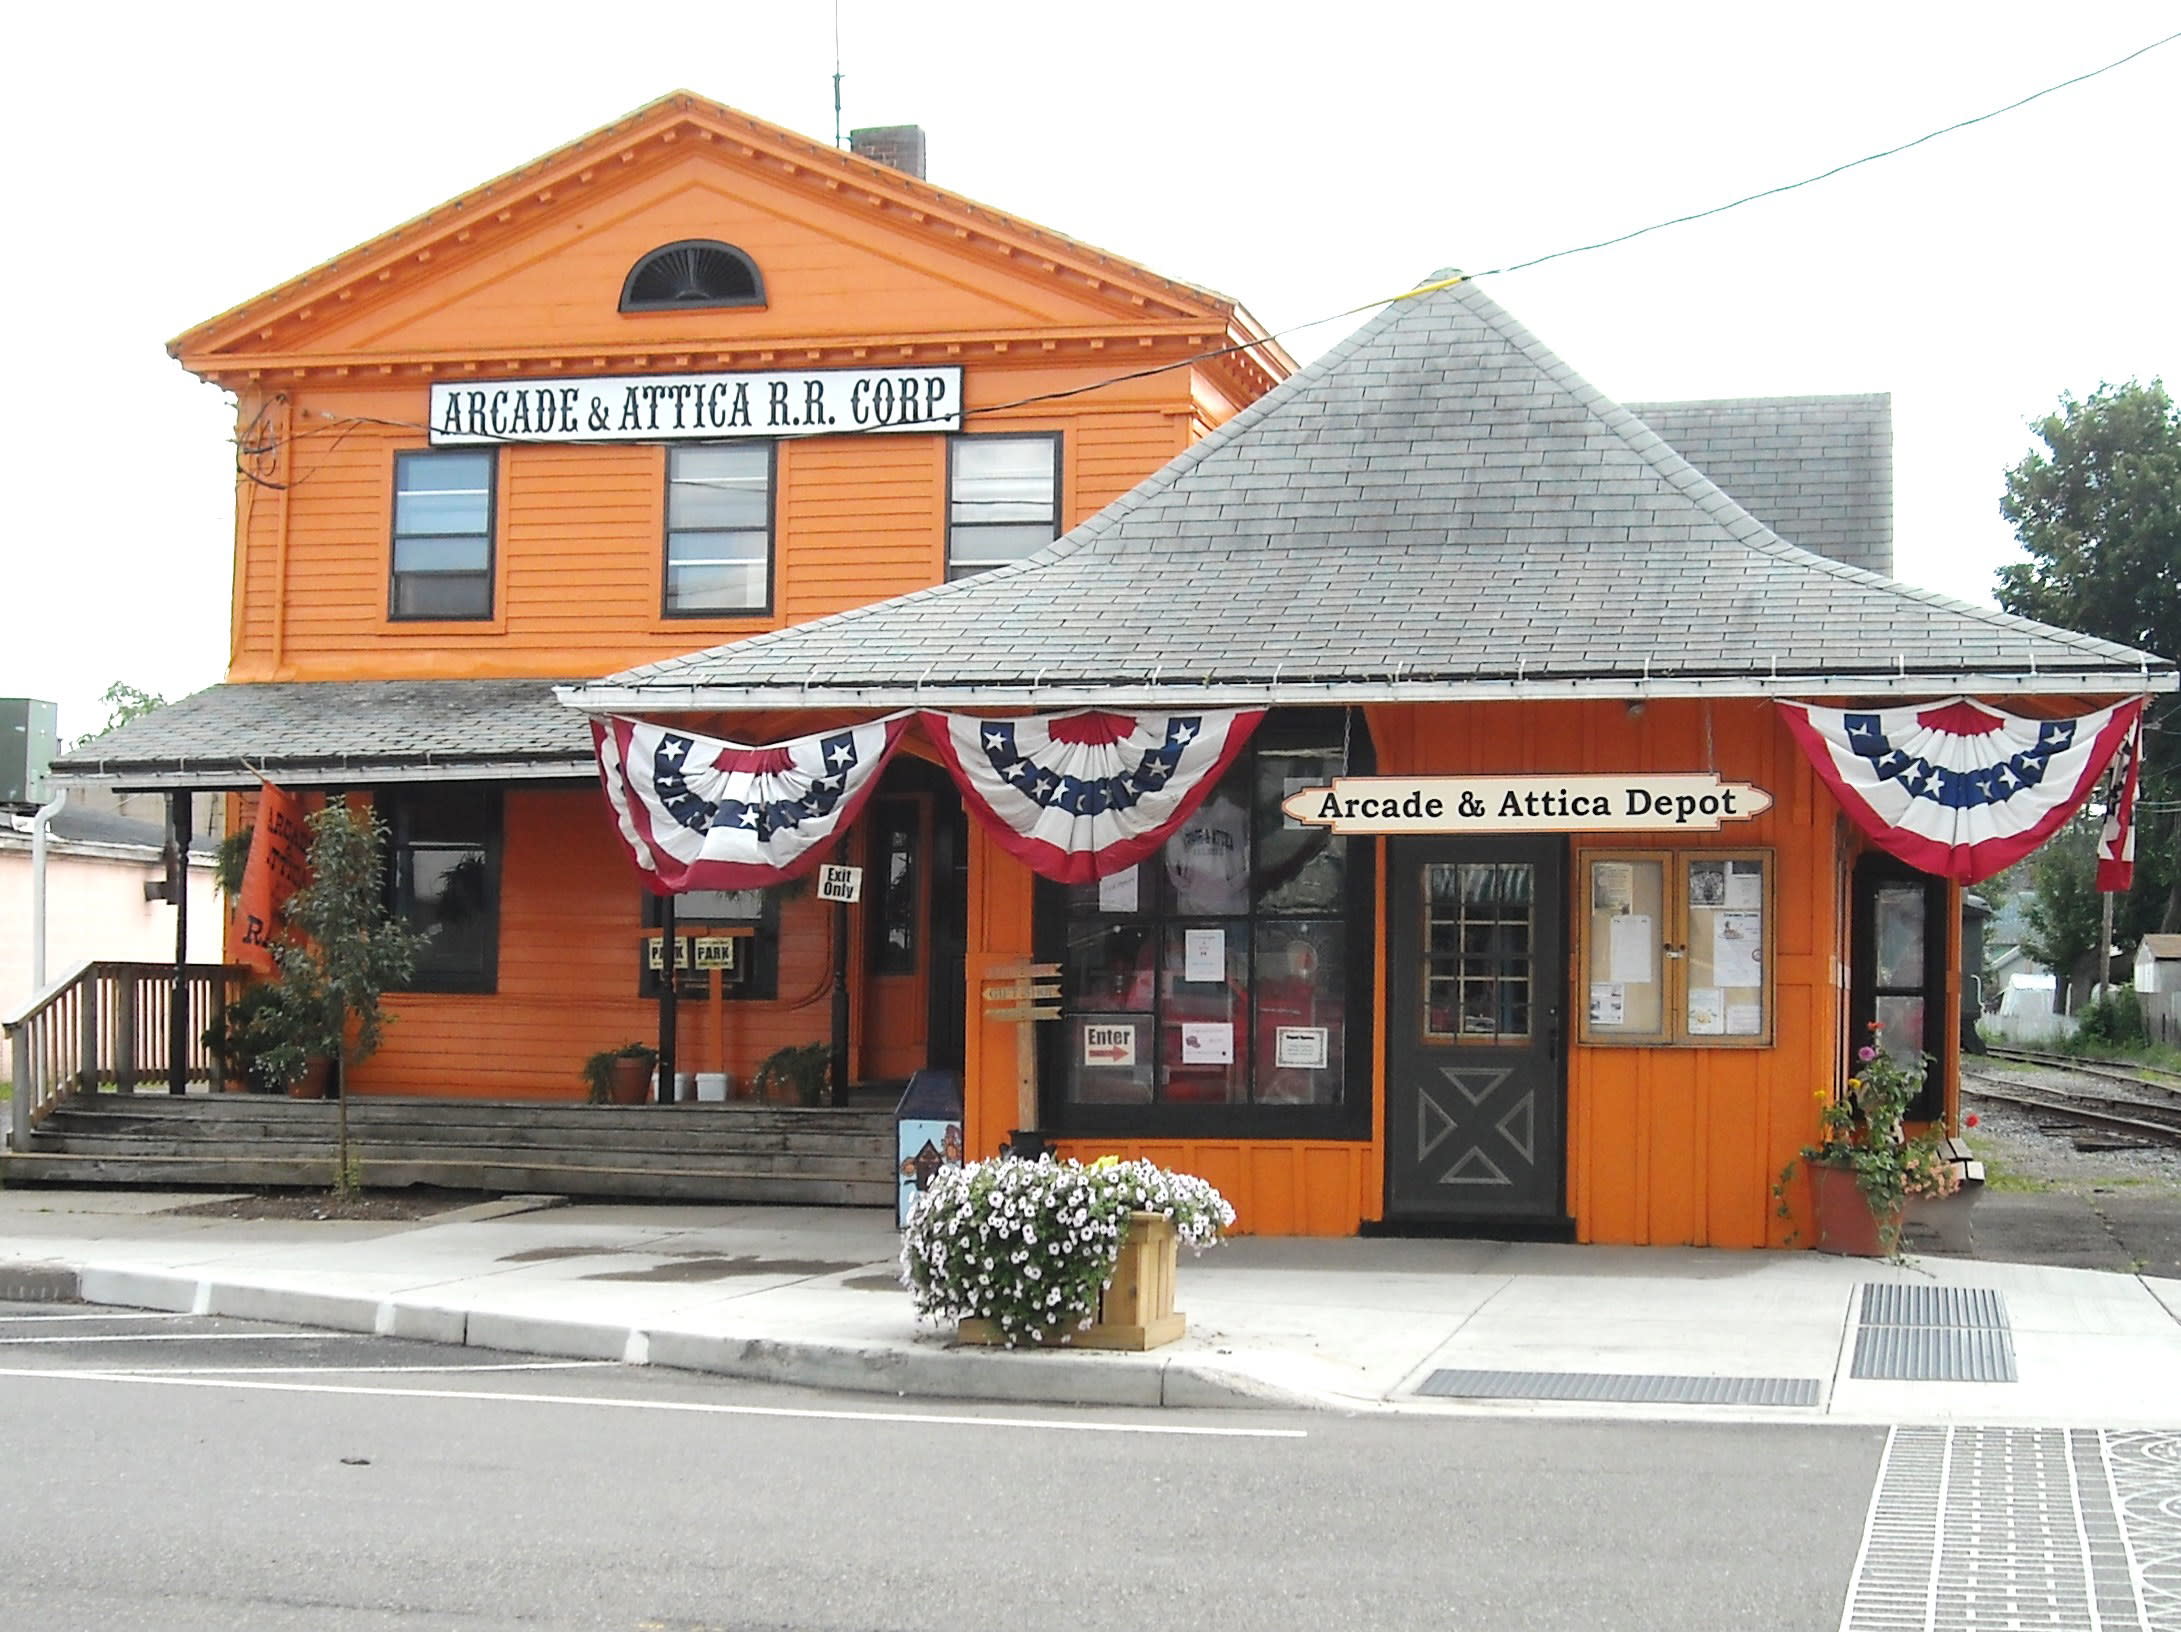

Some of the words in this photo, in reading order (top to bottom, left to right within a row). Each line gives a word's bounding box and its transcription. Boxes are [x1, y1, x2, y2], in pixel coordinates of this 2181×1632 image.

[440, 387, 579, 436] ARCADE
[587, 396, 611, 431] &
[618, 383, 752, 430] ATTICA
[767, 379, 836, 427] R.R.
[1317, 791, 1443, 818] Arcade
[1458, 791, 1486, 818] &
[1497, 788, 1612, 817] Attica
[1625, 788, 1737, 823] Depot
[828, 867, 851, 883] Exit
[823, 881, 854, 899] Only
[652, 946, 684, 960] PK
[697, 945, 730, 961] PARK
[1088, 1028, 1131, 1046] Enter
